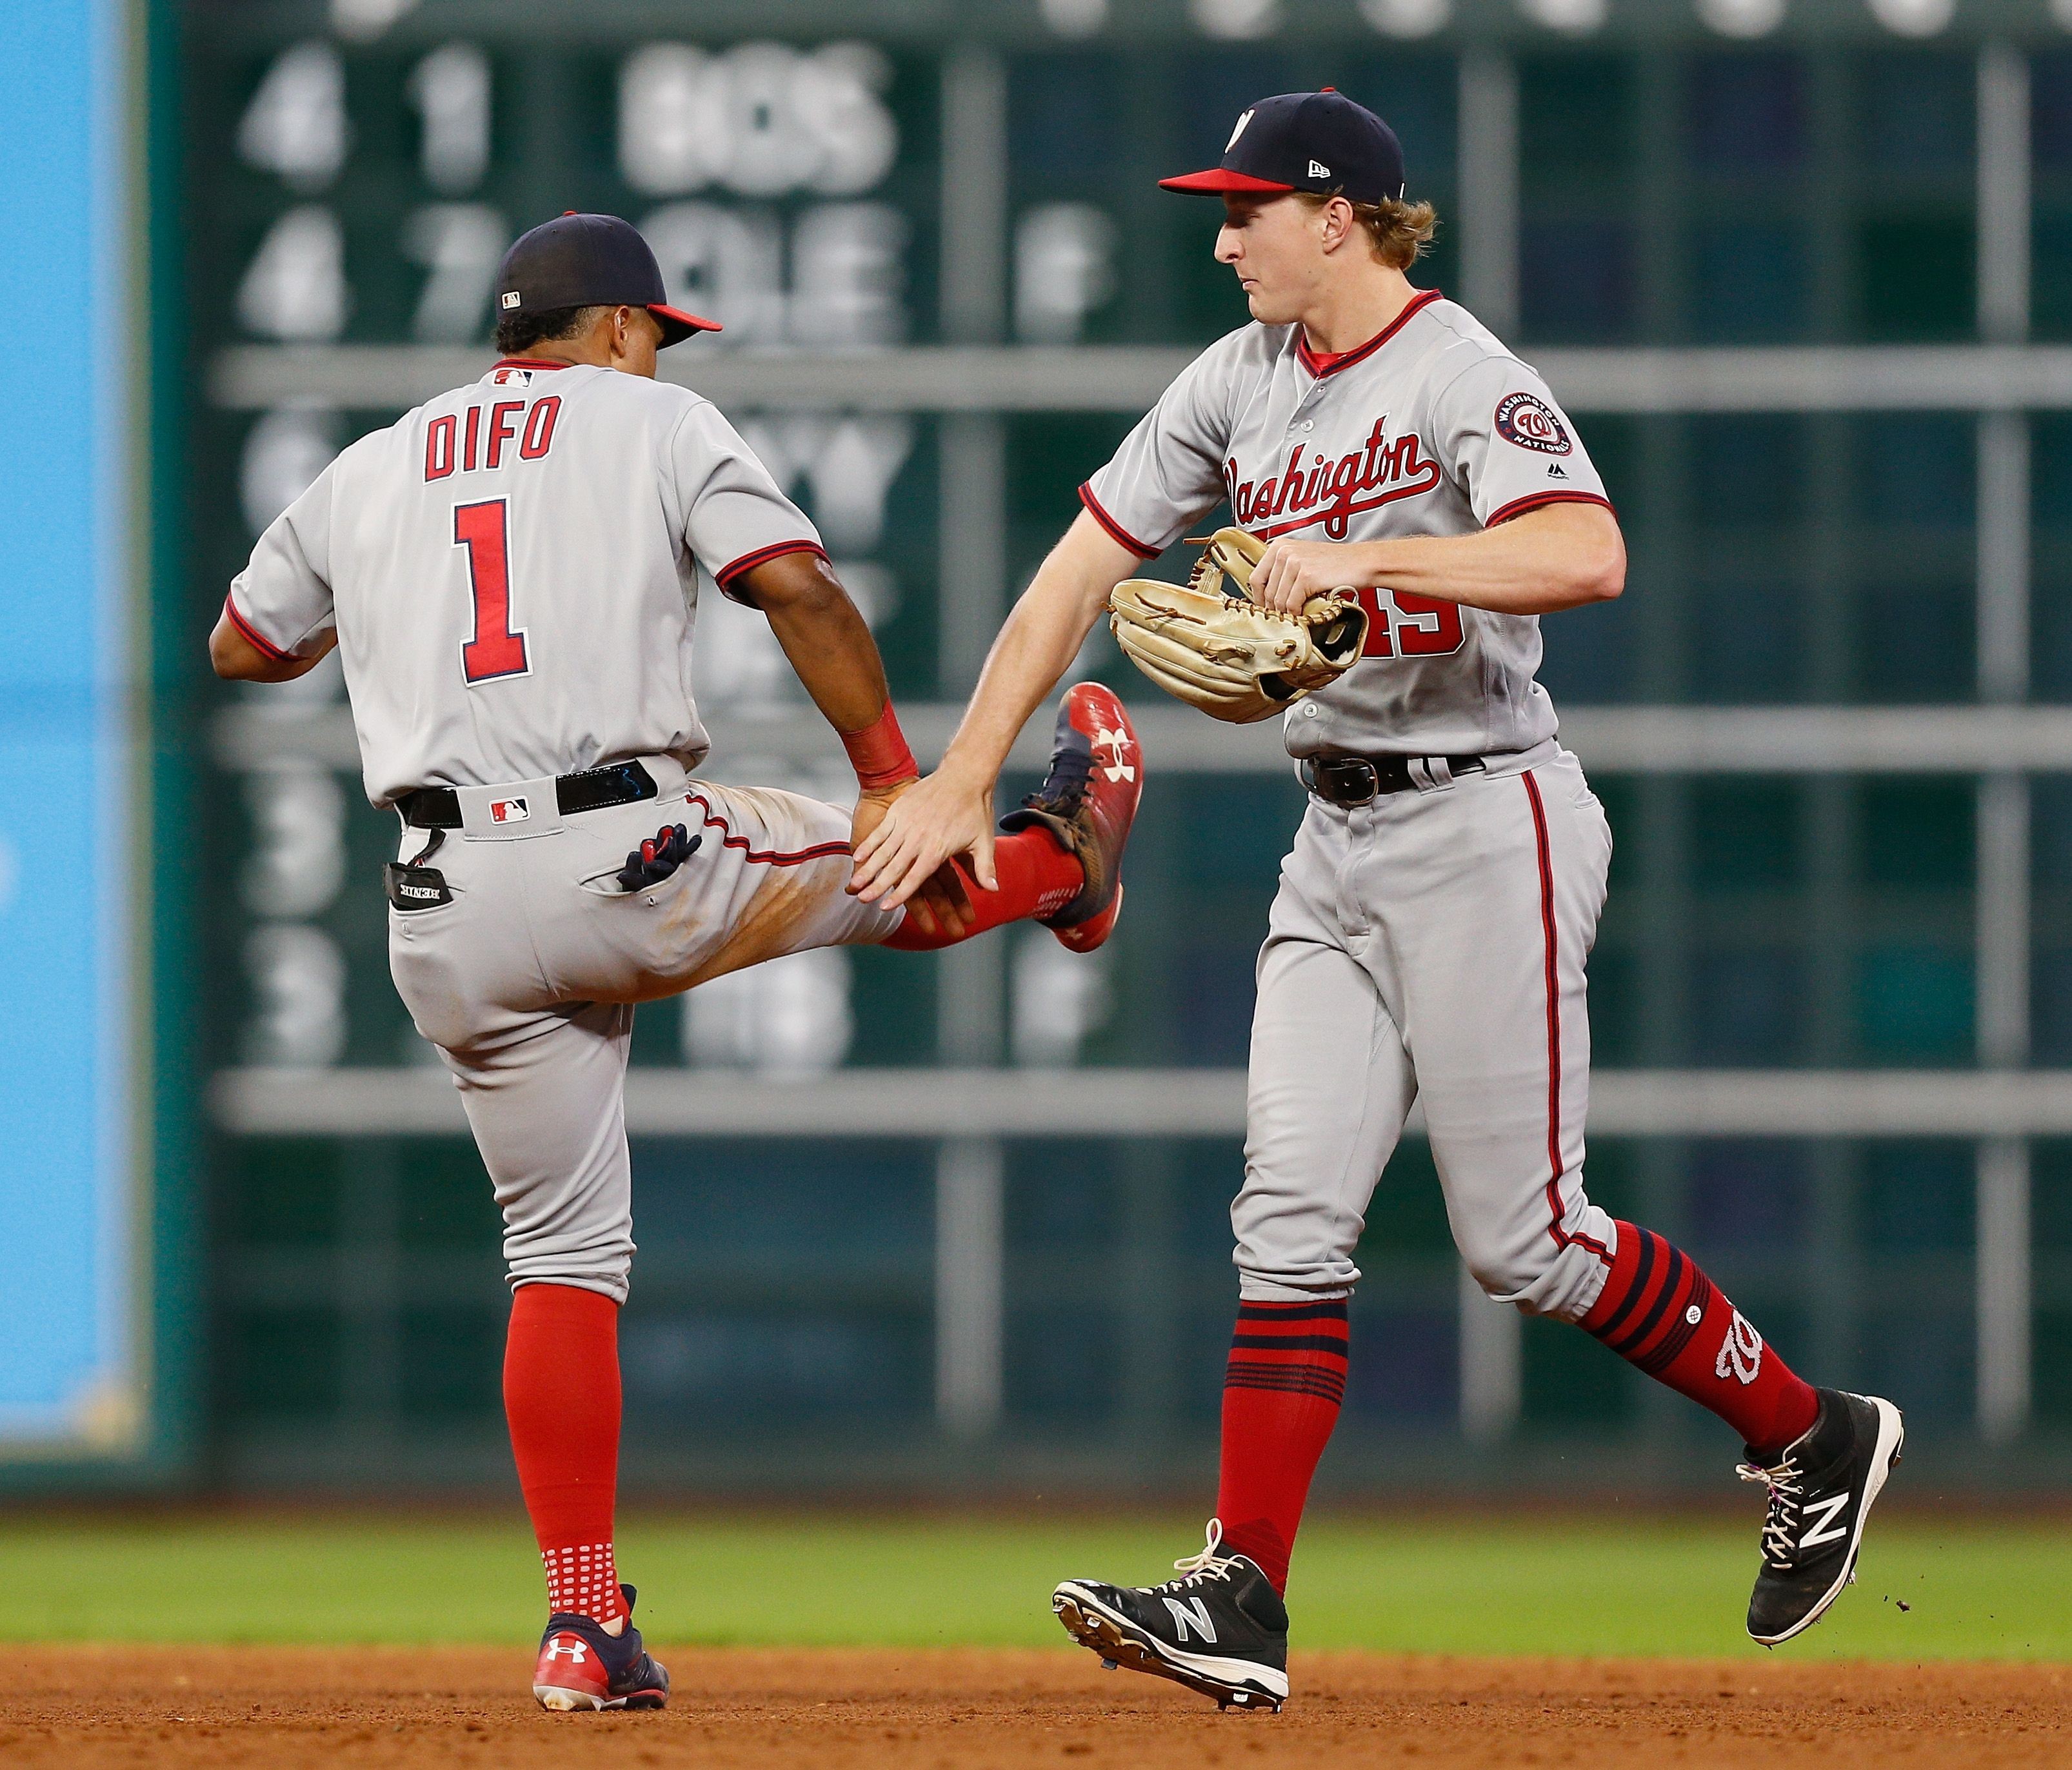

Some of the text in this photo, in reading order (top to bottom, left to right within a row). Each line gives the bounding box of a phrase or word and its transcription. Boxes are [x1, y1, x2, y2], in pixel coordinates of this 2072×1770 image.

[1499, 395, 1560, 426] WASHINGTON
[423, 394, 564, 485] DIFO
[1513, 435, 1569, 453] NATIONALS
[451, 493, 533, 688] 1
[1799, 1492, 1849, 1549] N
[1162, 1596, 1217, 1643] N
